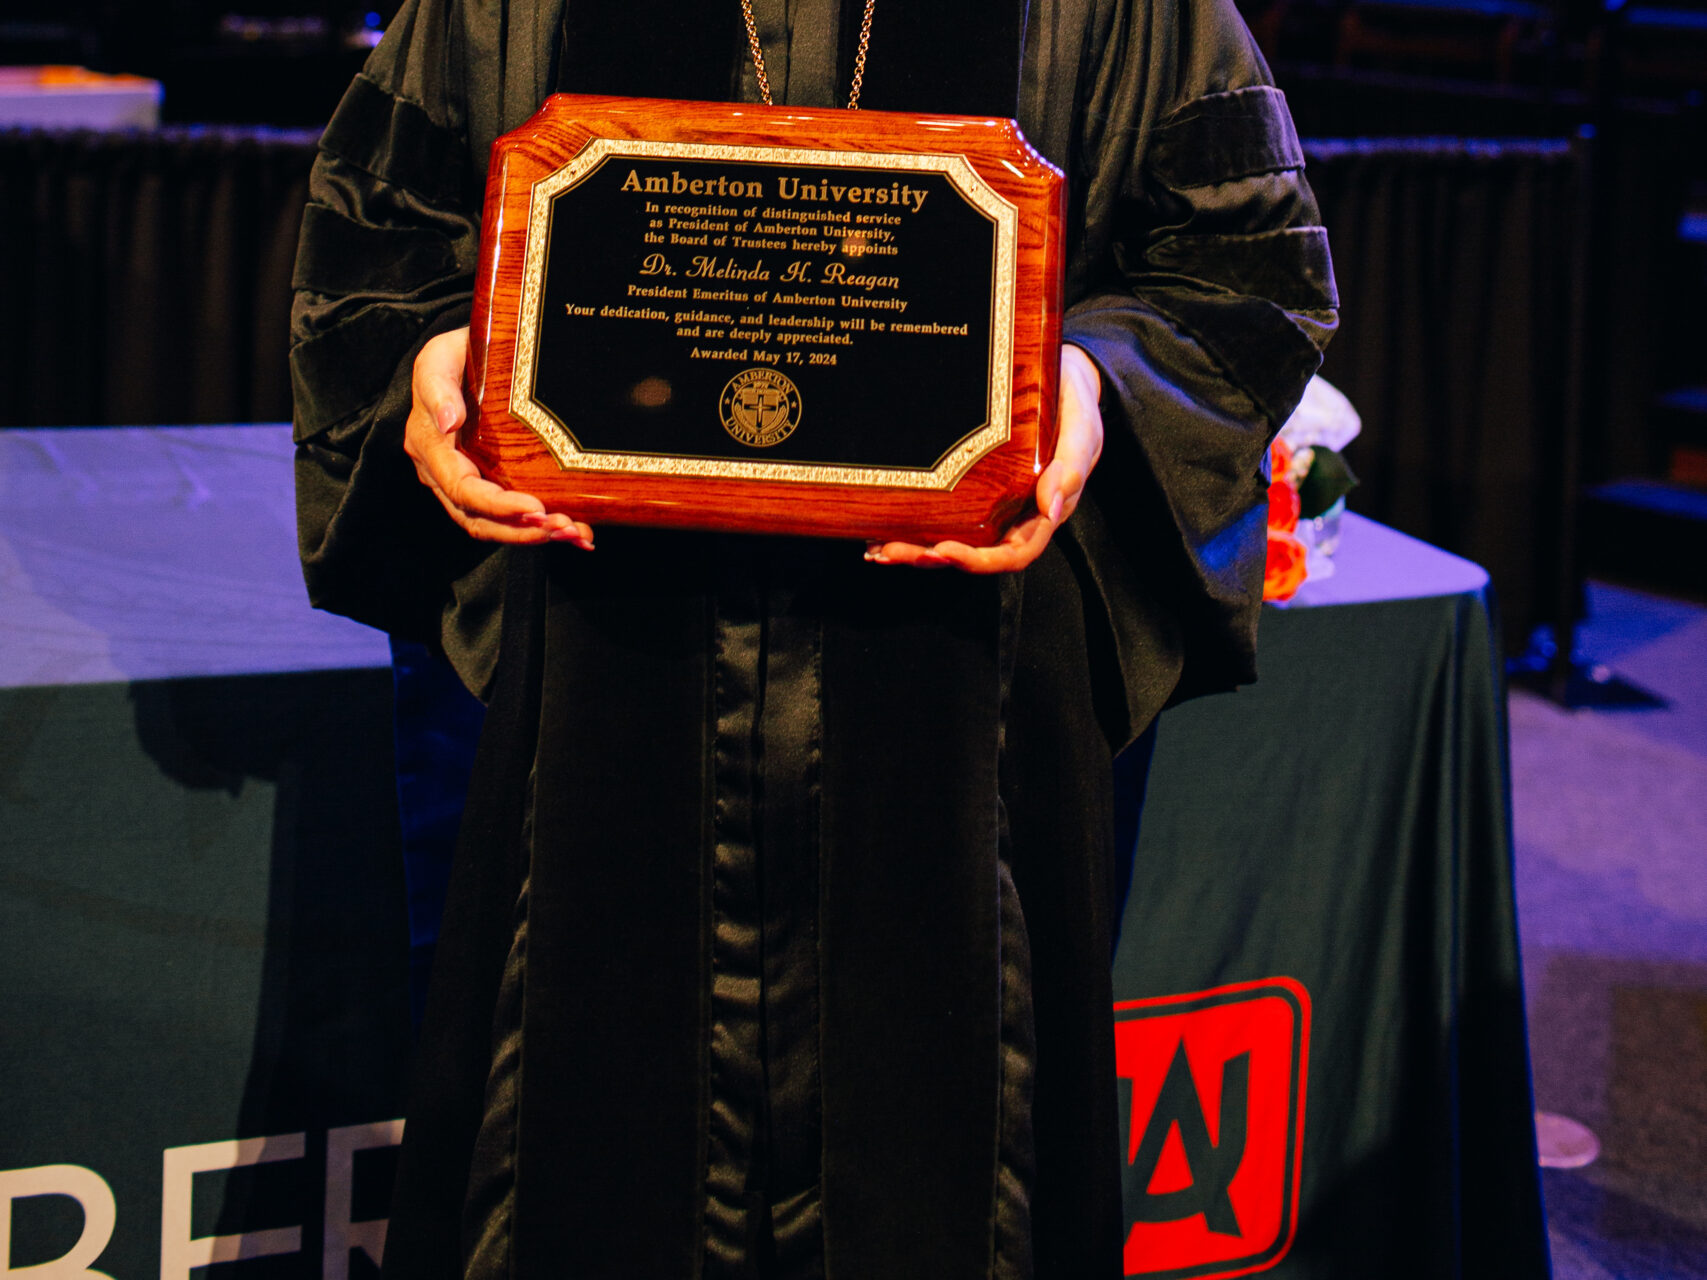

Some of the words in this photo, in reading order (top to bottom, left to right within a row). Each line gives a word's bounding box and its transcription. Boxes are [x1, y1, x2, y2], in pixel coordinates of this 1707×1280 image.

[620, 169, 763, 198] Amberton
[778, 177, 929, 213] University
[645, 201, 659, 213] In
[664, 204, 738, 218] recognition
[743, 207, 757, 218] of
[762, 207, 851, 223] distinguished
[855, 213, 902, 225] service
[649, 219, 663, 229] as
[668, 218, 729, 232] President
[734, 221, 749, 233] of
[753, 222, 817, 236] Amberton
[823, 225, 895, 242] University,
[644, 231, 665, 243] the
[670, 233, 708, 246] Board
[713, 235, 728, 247] of
[732, 236, 787, 250] Trustees
[792, 238, 837, 255] hereby
[841, 243, 899, 257] appoints
[639, 253, 677, 276] Dr.
[685, 255, 770, 281] Melinda
[779, 261, 812, 283] H.
[820, 262, 900, 291] Reagan
[627, 284, 688, 299] President
[692, 288, 749, 302] Emeritus
[753, 291, 768, 303] of
[772, 292, 836, 306] Amberton
[841, 295, 908, 312] University
[565, 303, 596, 317] Your
[600, 305, 670, 322] dedication,
[674, 310, 735, 325] guidance,
[739, 314, 764, 325] and
[768, 314, 834, 331] leadership
[840, 318, 865, 330] will
[870, 319, 886, 331] be
[890, 322, 969, 336] remembered
[676, 326, 700, 337] and
[705, 329, 725, 338] are
[729, 327, 772, 344] deeply
[776, 331, 854, 346] appreciated.
[690, 347, 748, 361] Awarded
[753, 350, 780, 365] May
[786, 351, 804, 366] 17,
[809, 353, 838, 366] 2024
[732, 370, 794, 394] AMBERTON
[726, 417, 794, 445] UNIVERSITY
